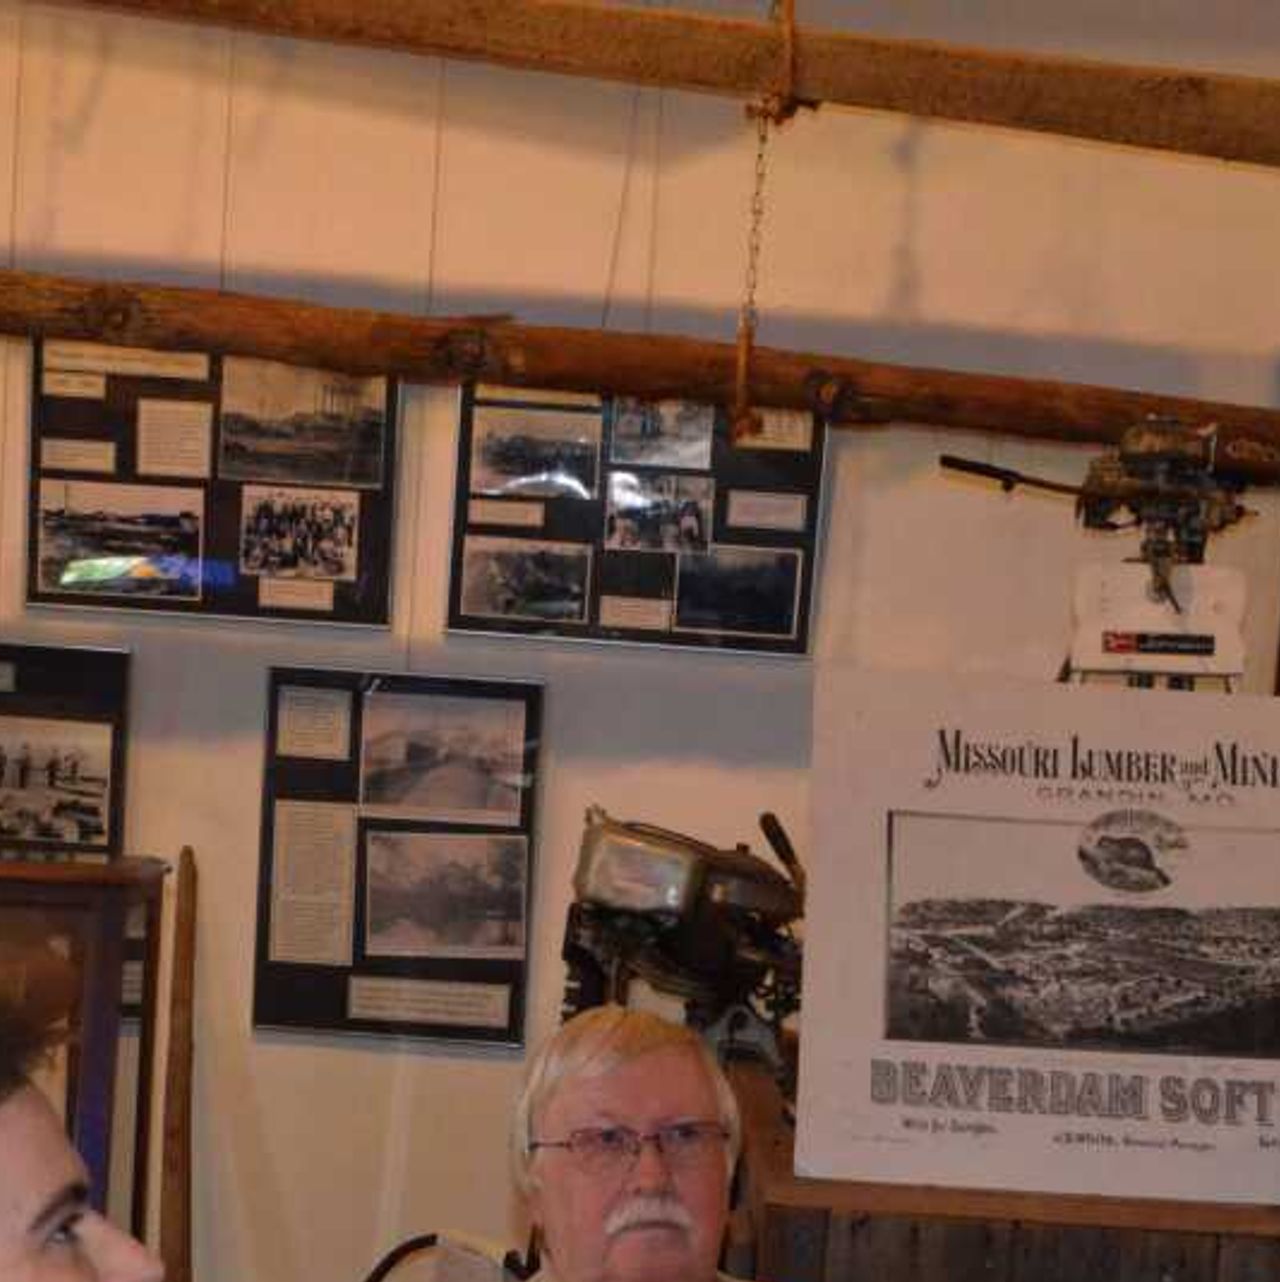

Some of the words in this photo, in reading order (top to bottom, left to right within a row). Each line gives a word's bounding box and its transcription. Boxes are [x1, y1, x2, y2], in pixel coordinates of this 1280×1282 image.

[924, 729, 1060, 788] MISSOURI
[1070, 733, 1177, 784] LUMBER
[870, 1058, 1149, 1120] BEAVERDAM
[1158, 1075, 1275, 1127] SOFT
